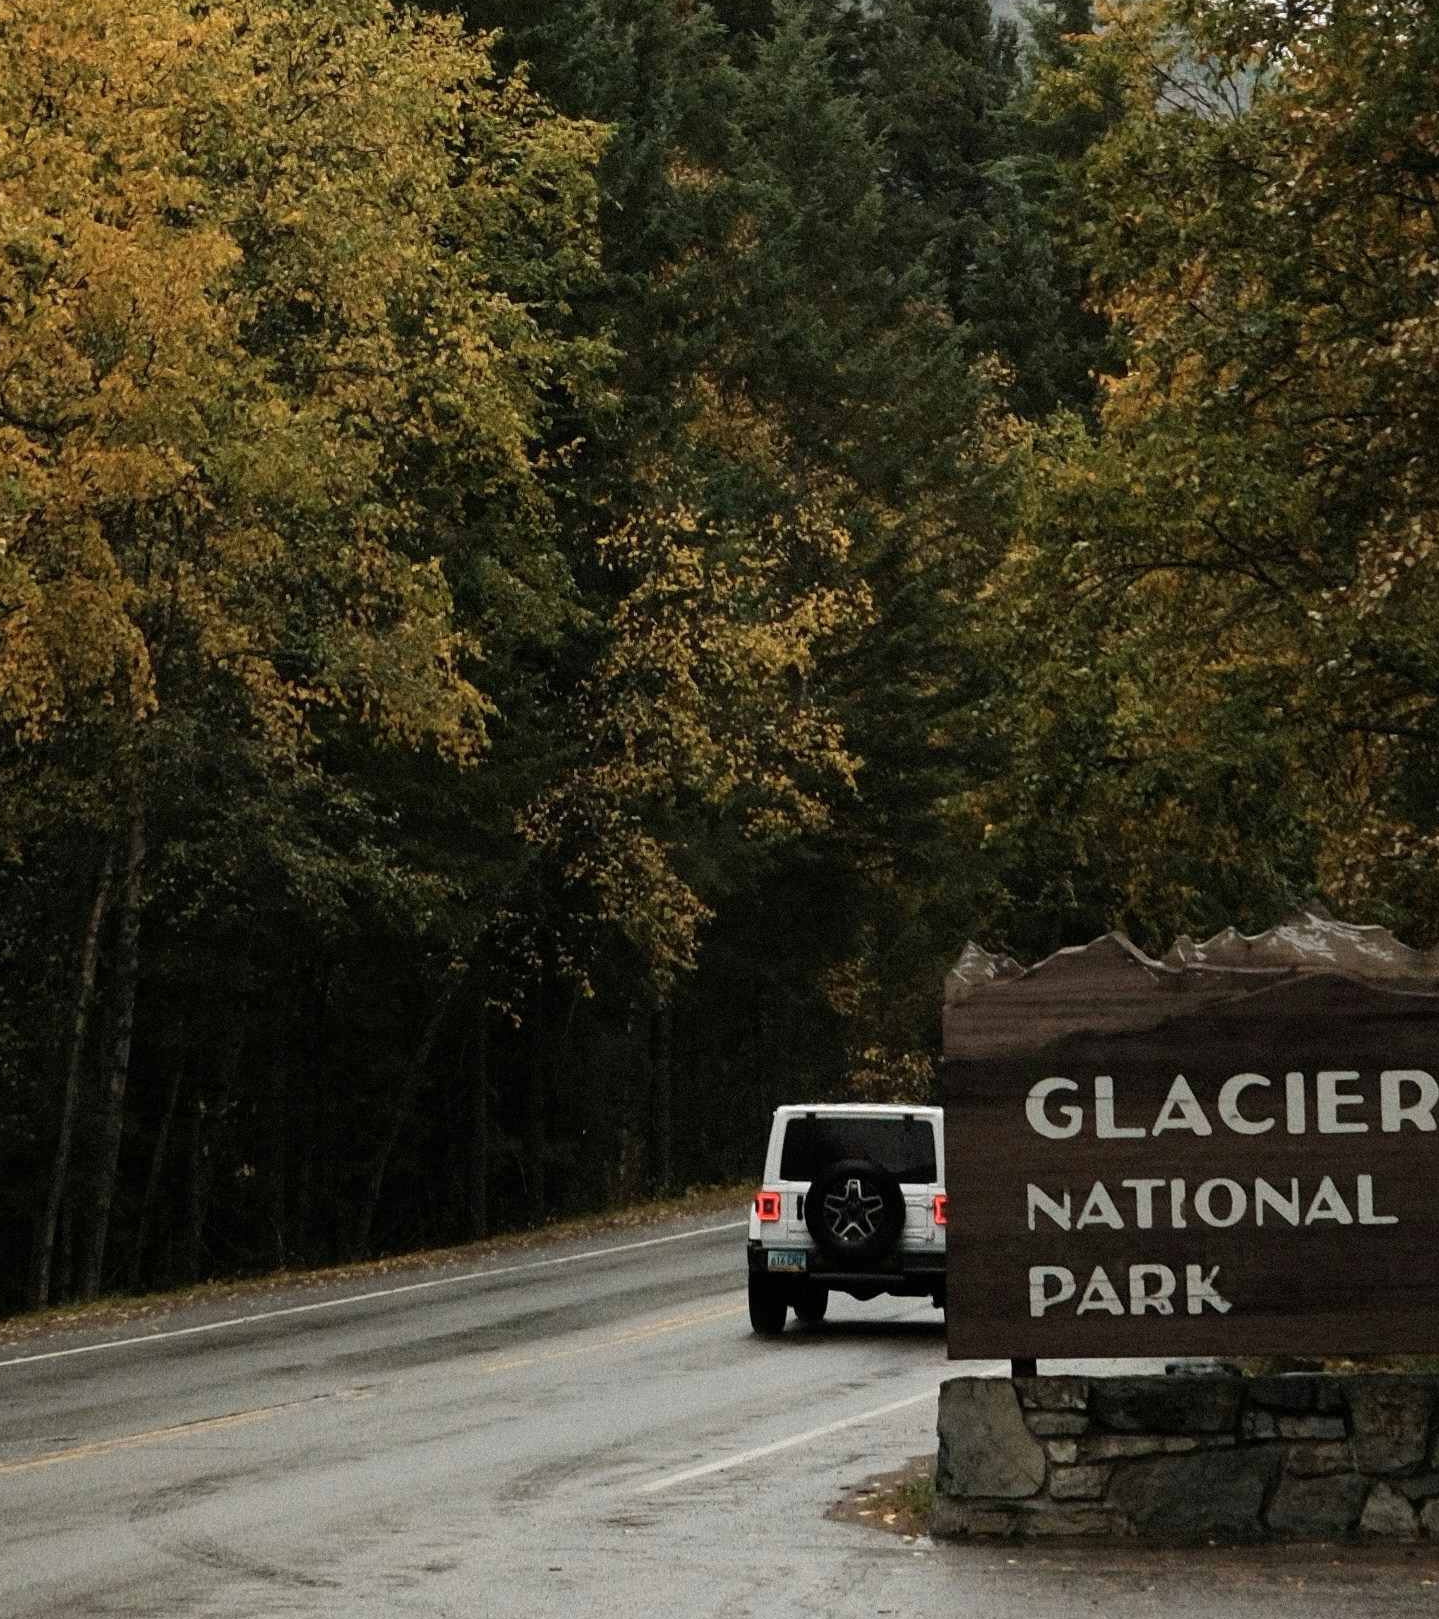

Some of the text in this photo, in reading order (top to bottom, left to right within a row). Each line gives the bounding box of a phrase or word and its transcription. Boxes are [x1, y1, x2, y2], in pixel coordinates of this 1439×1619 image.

[1025, 1070, 1439, 1140] GLACIER
[1027, 1174, 1399, 1231] NATIONAL
[1028, 1264, 1233, 1317] PARK
